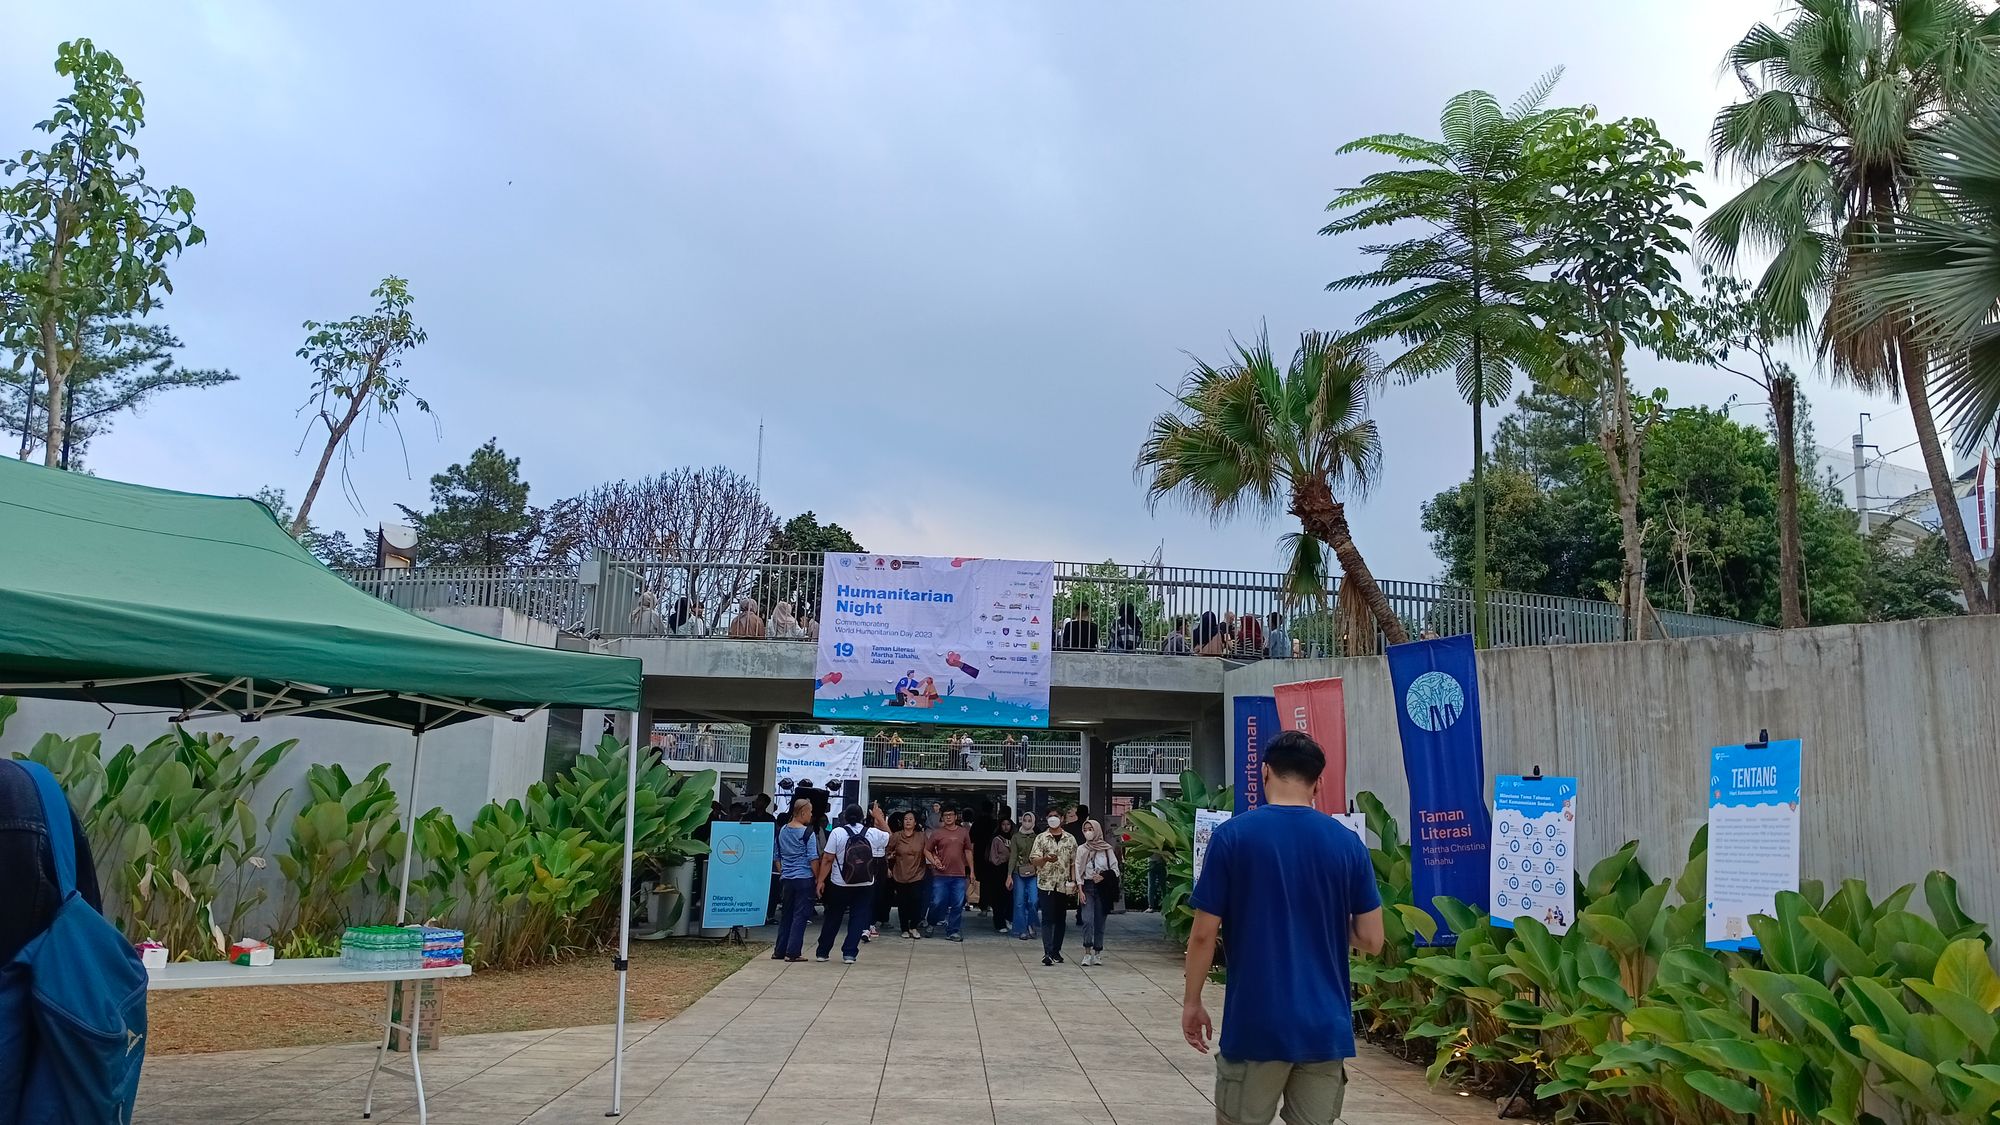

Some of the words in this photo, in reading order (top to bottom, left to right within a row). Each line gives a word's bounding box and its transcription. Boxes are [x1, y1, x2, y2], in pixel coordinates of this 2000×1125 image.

[837, 584, 954, 603] Humanitarian
[836, 599, 883, 616] Night
[835, 618, 890, 629] Commemorating
[856, 628, 899, 636] Humanitarian
[900, 630, 914, 638] Day
[833, 642, 854, 657] 19
[1294, 706, 1307, 734] an
[1244, 716, 1258, 812] adaritaman
[1731, 766, 1777, 788] TENTANG
[1418, 810, 1464, 823] Taman
[1421, 824, 1472, 840] Literasi
[1422, 845, 1450, 854] Martha
[1450, 842, 1486, 852] Christina
[1424, 857, 1454, 866] Tiahahu
